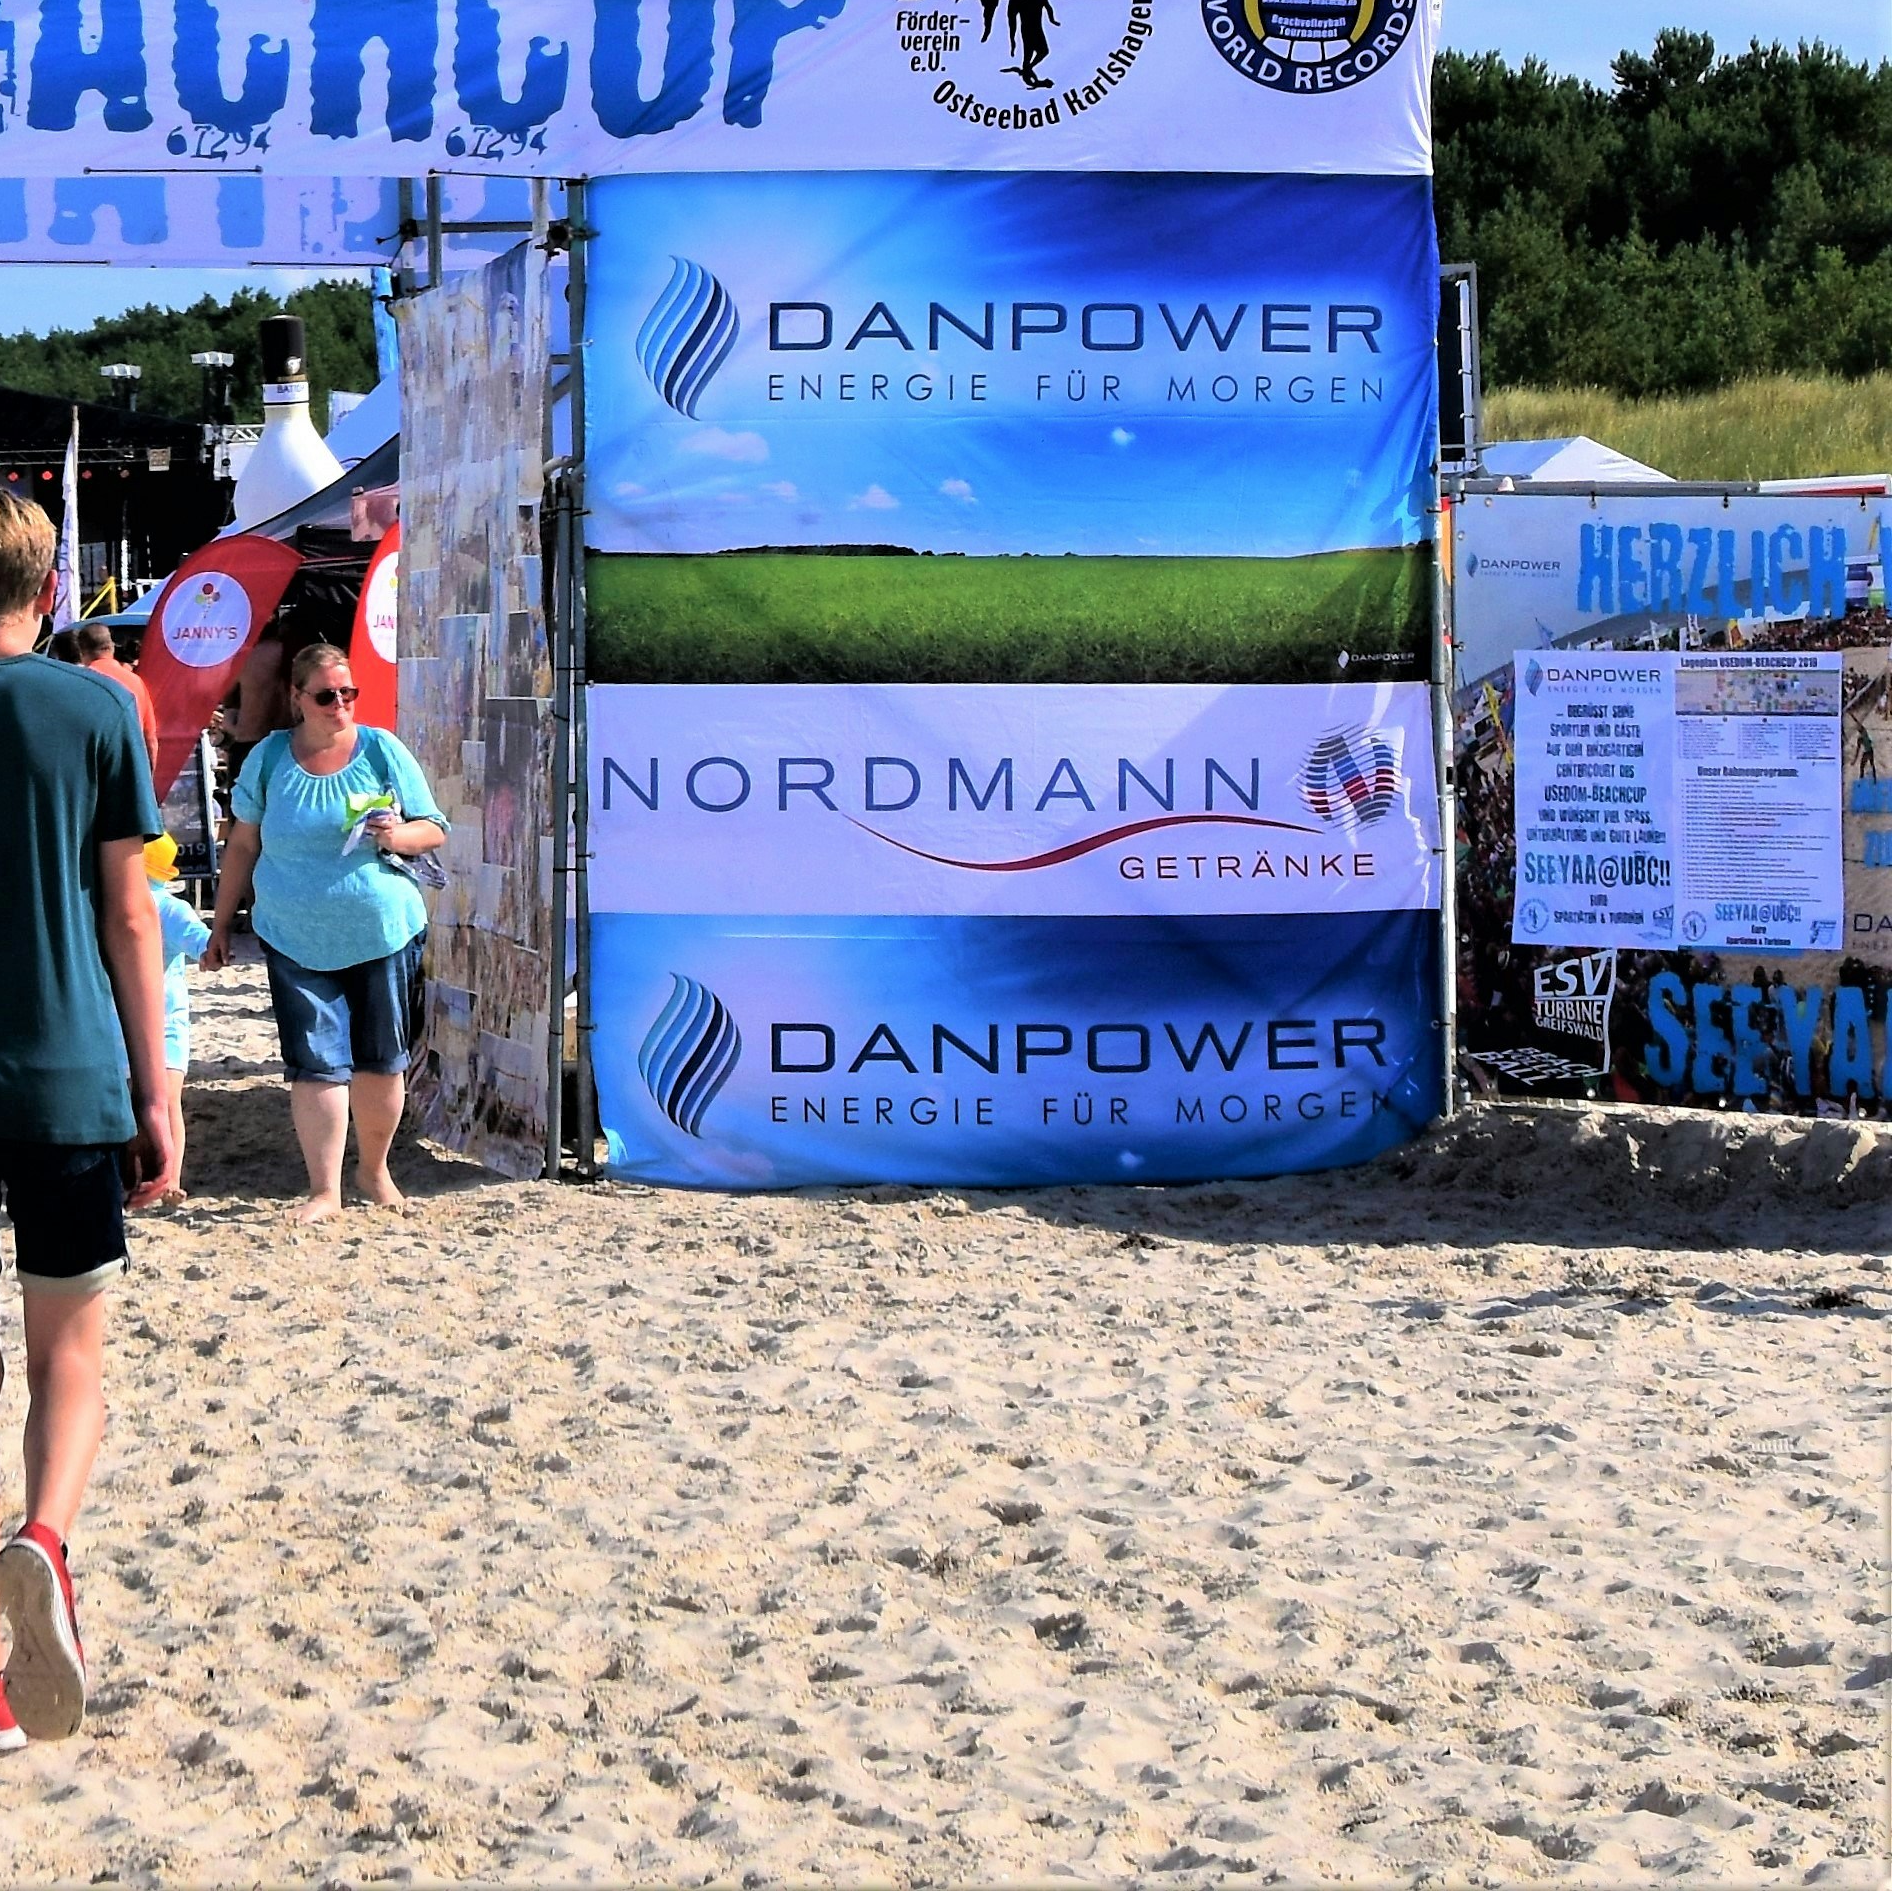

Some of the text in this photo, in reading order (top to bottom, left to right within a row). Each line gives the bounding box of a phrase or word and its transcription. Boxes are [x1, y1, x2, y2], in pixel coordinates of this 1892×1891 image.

[896, 9, 971, 32] Förder-
[1271, 13, 1347, 29] Beachvolleyball
[1279, 25, 1338, 38] Tournament
[901, 31, 960, 52] verein
[932, 79, 1061, 130] Ostseebad
[769, 301, 1383, 354] DANPOWER
[768, 369, 1384, 404] ENERGIE FÜR MORGEN
[1480, 559, 1561, 570] DANPOWER
[1577, 521, 1847, 621] HERZLICH
[172, 626, 238, 640] JANNY'S
[373, 613, 396, 629] JAN
[1548, 668, 1661, 682] DANPOWER
[601, 756, 1260, 812] NORDMANN
[1544, 784, 1647, 803] USEDOM-BEACHCUP
[177, 841, 207, 856] 019
[1119, 848, 1376, 880] GETRÄNKE
[1524, 851, 1670, 888] SEEYAA@UBC!!
[1534, 950, 1611, 997] ESV
[1534, 999, 1604, 1025] TURBINE
[1535, 1015, 1604, 1042] GREIFSWALD
[771, 1017, 1389, 1074] DANPOWER
[771, 1089, 1389, 1126] ENERGIE FÜR MORGEN
